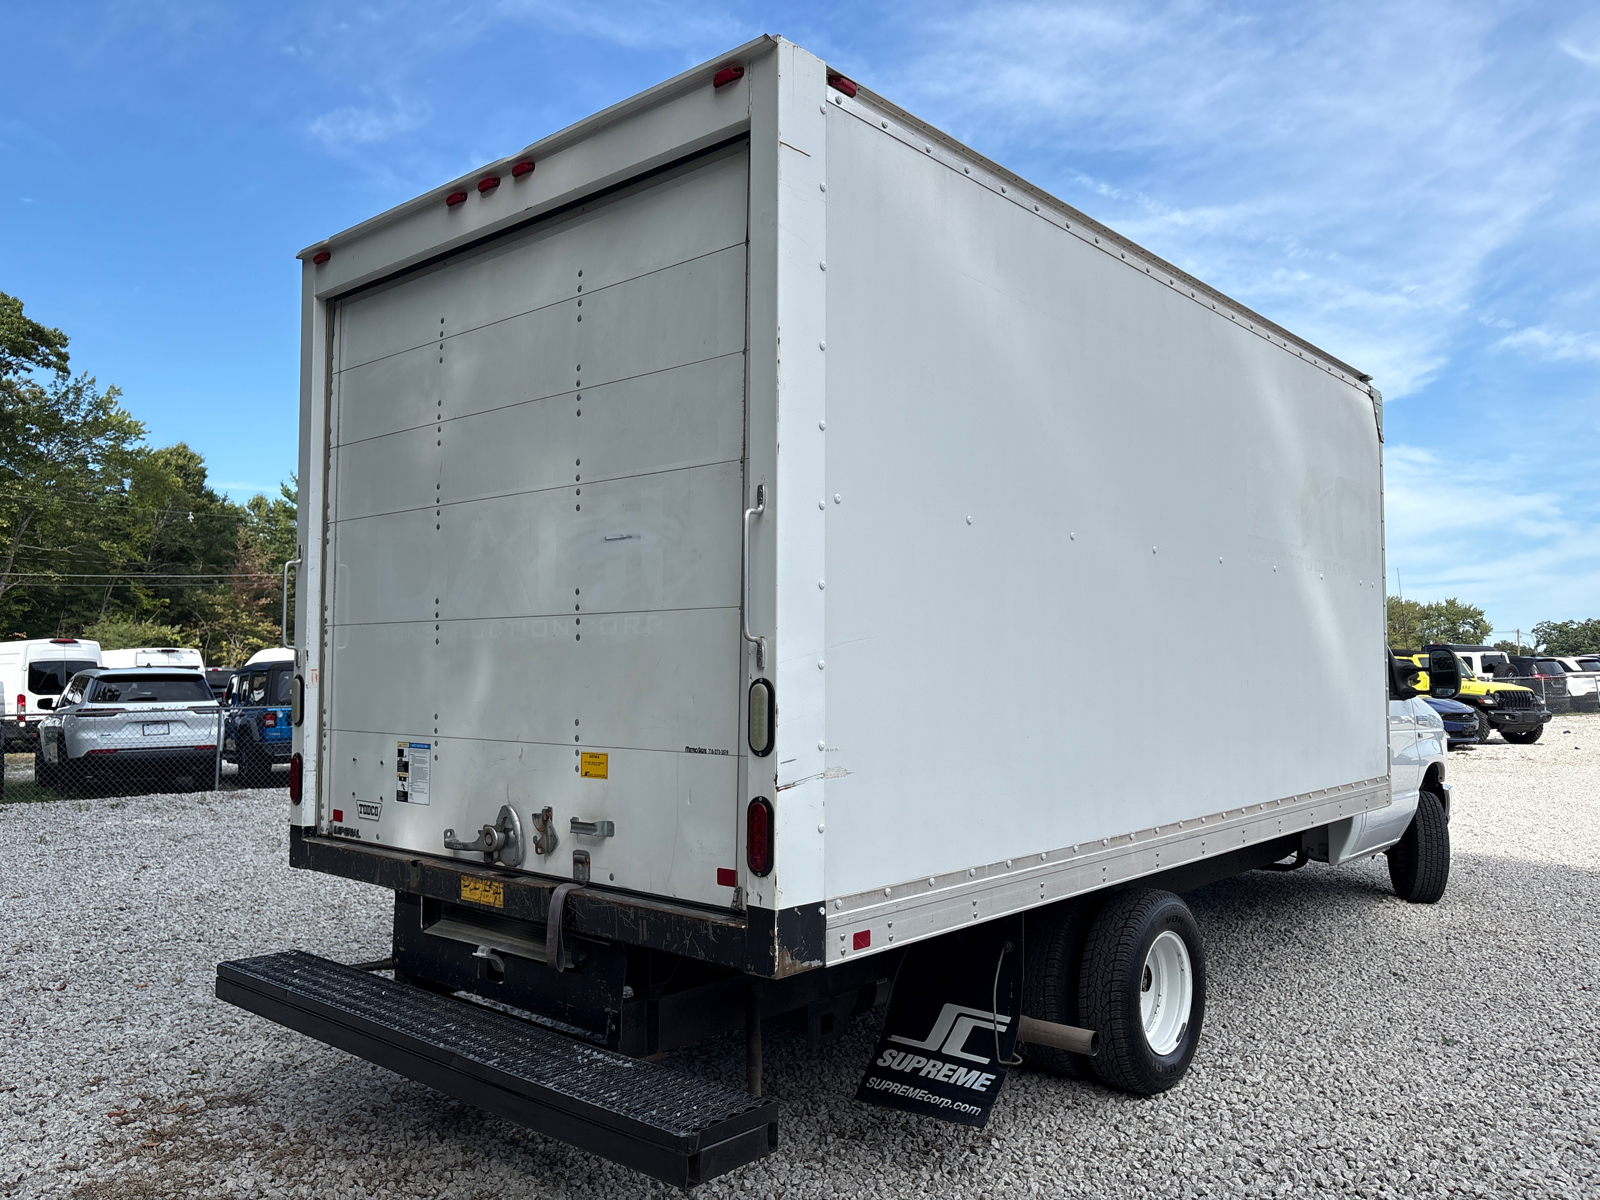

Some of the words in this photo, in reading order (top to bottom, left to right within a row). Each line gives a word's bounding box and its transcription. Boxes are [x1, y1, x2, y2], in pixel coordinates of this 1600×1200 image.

[358, 803, 379, 817] TODCO
[876, 1048, 997, 1092] SUPREME
[866, 1076, 982, 1116] SUPREMEcorp.com
